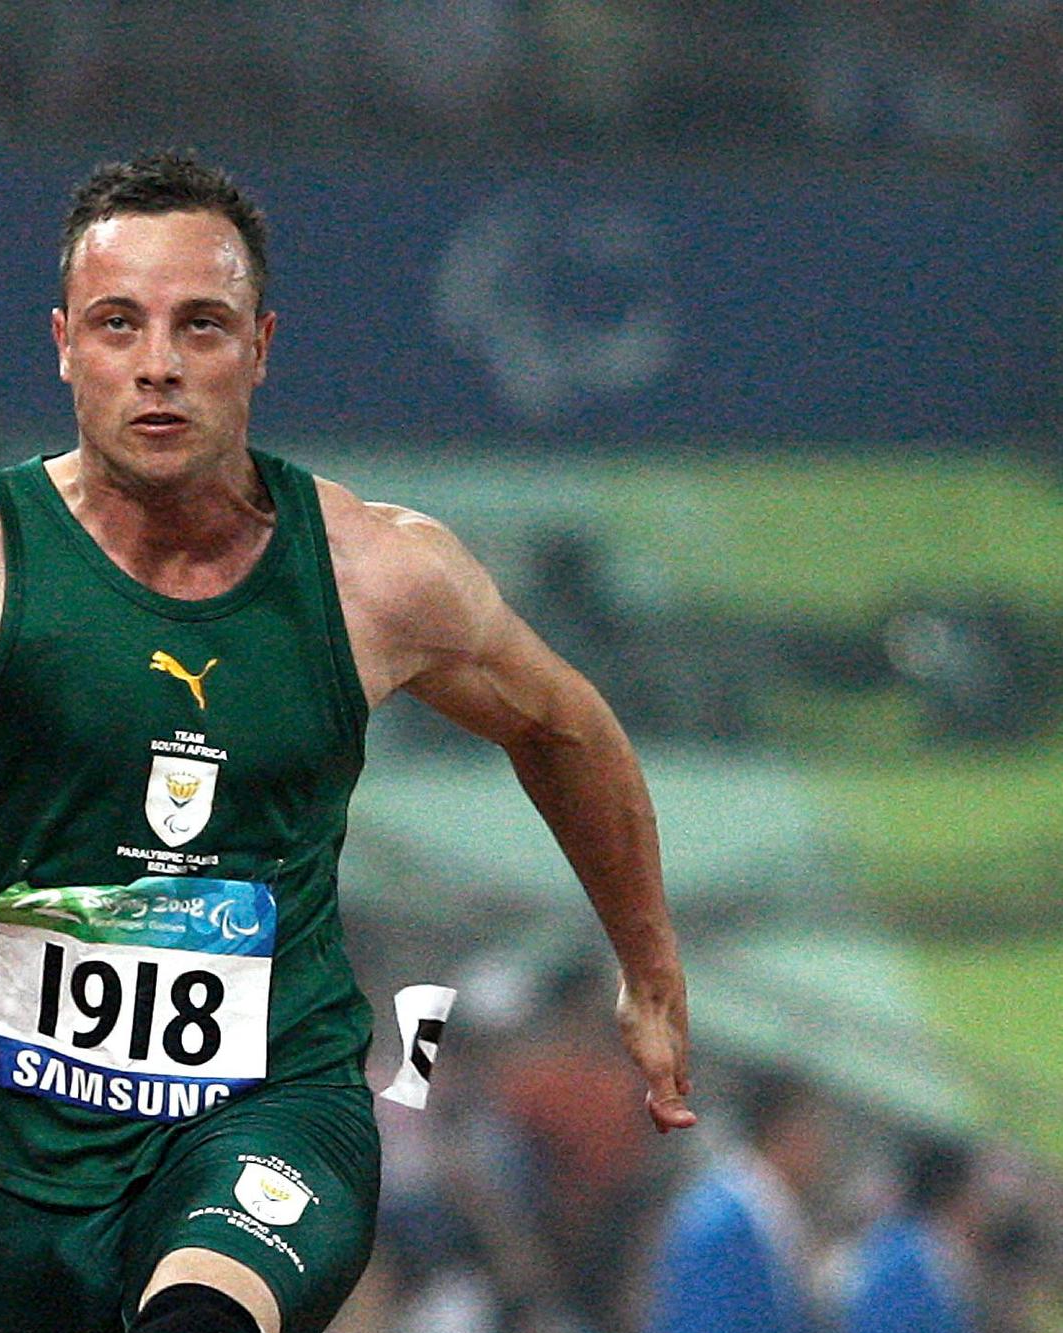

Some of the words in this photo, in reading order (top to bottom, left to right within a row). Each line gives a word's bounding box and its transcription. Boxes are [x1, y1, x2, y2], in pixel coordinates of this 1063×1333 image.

[175, 730, 205, 744] TEAM
[151, 740, 186, 753] SOUTH
[186, 744, 228, 761] AFRICA
[117, 846, 184, 863] PARALYMPIC
[152, 897, 205, 918] 2008
[38, 942, 225, 1066] 1918
